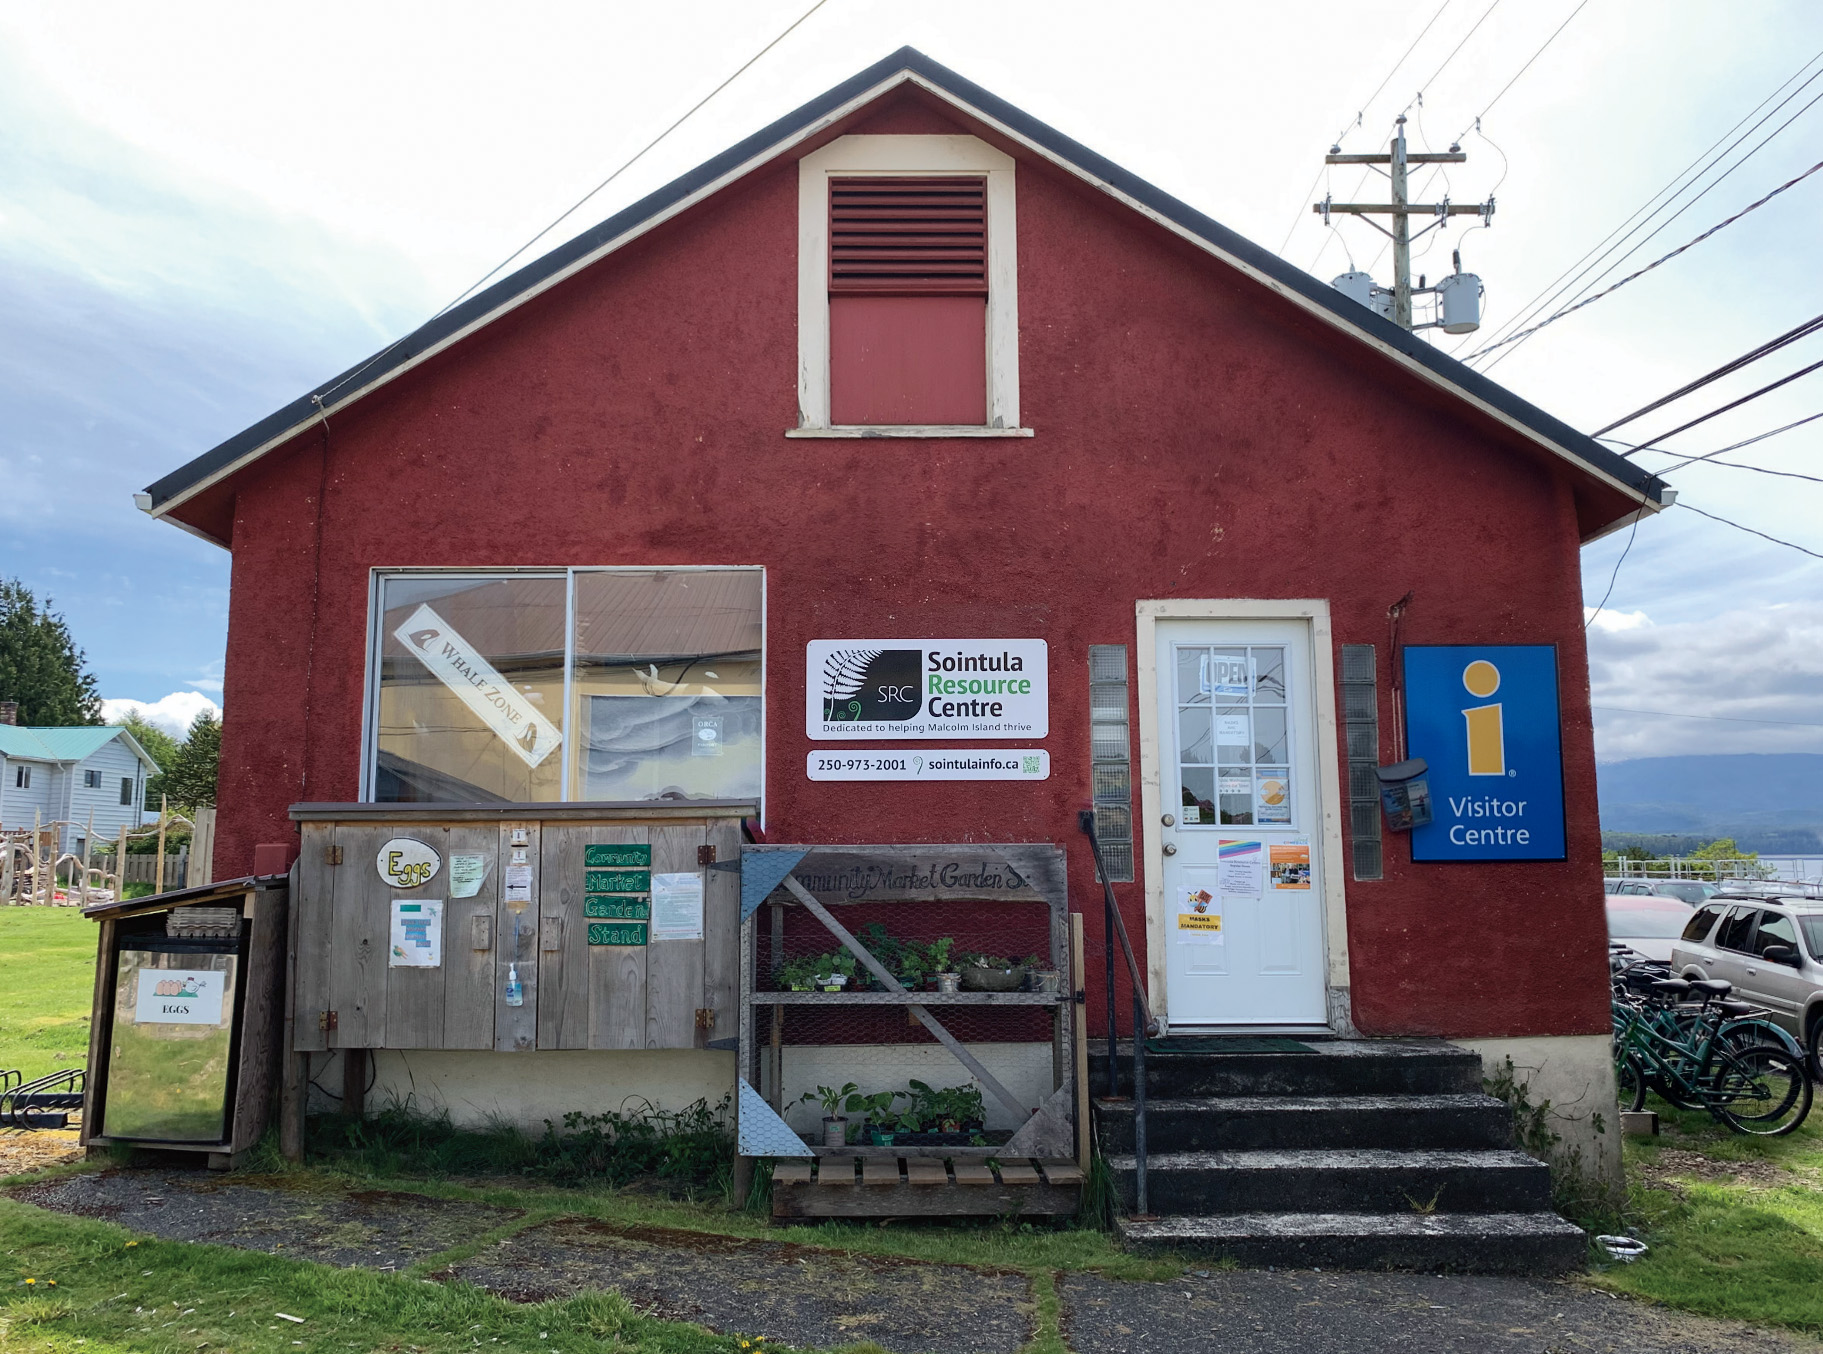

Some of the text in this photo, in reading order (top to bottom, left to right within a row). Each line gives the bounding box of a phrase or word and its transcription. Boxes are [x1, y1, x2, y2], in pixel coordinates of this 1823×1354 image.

[928, 651, 1023, 672] Sointula
[441, 641, 523, 724] WHALE ZONE
[1205, 661, 1249, 685] OPEN
[877, 685, 914, 703] SRC
[928, 674, 1031, 695] Resource
[928, 696, 1003, 717] Centre
[823, 722, 1032, 734] Dedicated to helping Malcolm Island thrive
[818, 758, 1019, 771] 250-973-2001 sointulainfo.ca
[1448, 796, 1527, 818] Visitor
[1449, 824, 1530, 845] Centre
[585, 847, 648, 866] Community
[388, 851, 431, 887] Eggs
[868, 864, 938, 890] Market
[940, 862, 1002, 889] Garden
[588, 873, 642, 891] Market
[585, 898, 646, 917] Garden
[588, 924, 642, 944] Stand
[162, 1004, 190, 1015] EGGS
